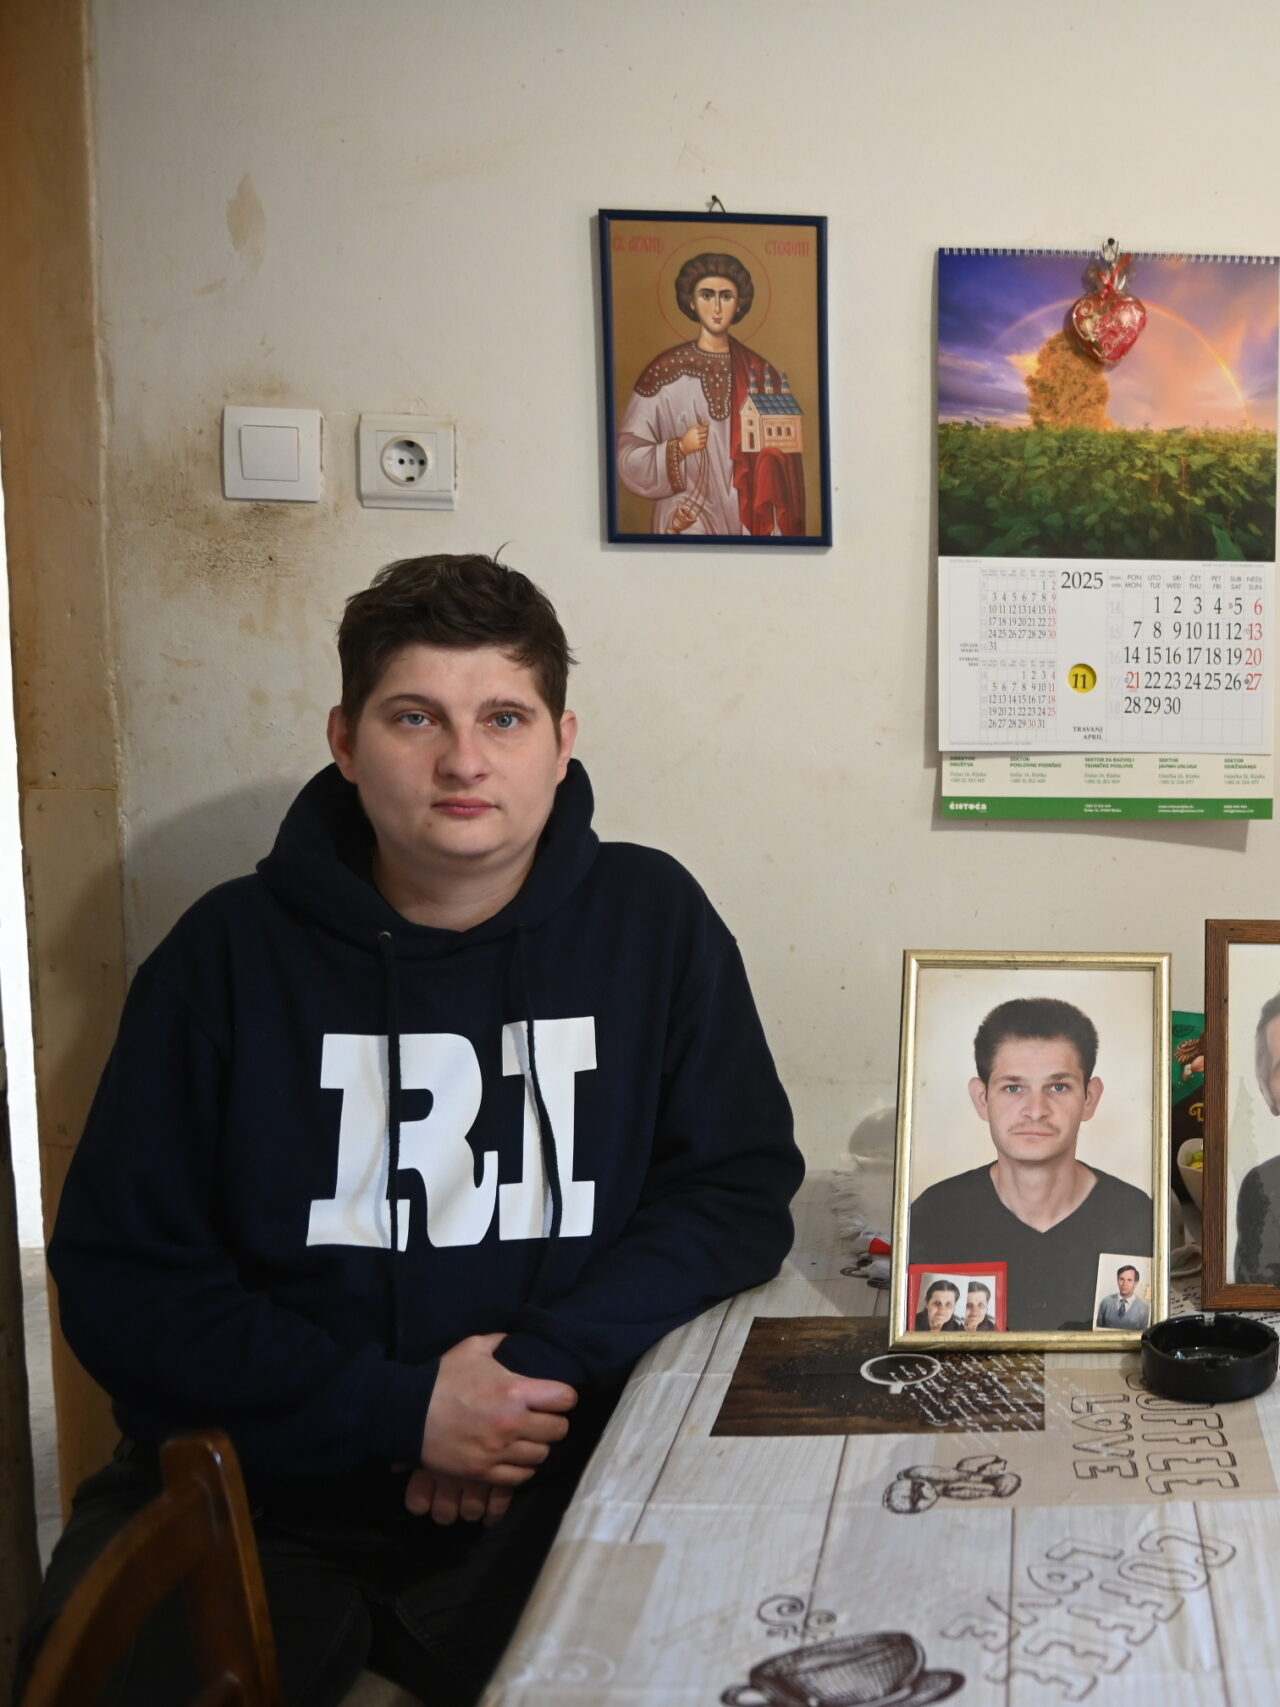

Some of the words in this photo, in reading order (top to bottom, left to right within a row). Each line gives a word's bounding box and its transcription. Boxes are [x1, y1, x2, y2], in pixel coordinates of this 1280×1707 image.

[1052, 580, 1057, 591] 2
[1061, 571, 1104, 590] 2025
[992, 592, 997, 602] 3
[1002, 592, 1007, 602] 4
[1012, 592, 1017, 602] 5
[1022, 593, 1027, 602] 6
[1032, 592, 1036, 602] 7
[1042, 593, 1047, 602] 8
[1051, 593, 1057, 602] 9
[989, 604, 998, 613] 10
[999, 605, 1006, 614] 11
[1009, 604, 1017, 614] 12
[1019, 605, 1027, 614] 13
[1028, 605, 1036, 615] 14
[1039, 605, 1047, 614] 15
[1048, 605, 1057, 615] 16
[1155, 596, 1160, 614] 1
[1173, 596, 1182, 613] 2
[1194, 596, 1202, 614] 3
[1214, 598, 1222, 614] 4
[1234, 598, 1242, 615] 5
[1254, 599, 1263, 615] 6
[989, 616, 997, 626] 17
[999, 617, 1007, 626] 18
[1009, 617, 1017, 626] 19
[1018, 617, 1027, 627] 20
[1027, 617, 1035, 627] 21
[1038, 617, 1046, 627] 22
[1047, 617, 1057, 627] 23
[988, 629, 997, 638] 24
[998, 629, 1007, 639] 25
[1008, 629, 1017, 639] 26
[1018, 629, 1027, 639] 27
[1027, 629, 1036, 639] 28
[1038, 629, 1047, 639] 29
[1048, 629, 1057, 639] 30
[1134, 621, 1142, 638] 7
[1153, 622, 1162, 638] 8
[1173, 622, 1182, 639] 9
[1187, 622, 1202, 640] 10
[1207, 622, 1219, 640] 11
[1227, 623, 1242, 640] 12
[1248, 623, 1262, 640] 13
[989, 641, 997, 651] 31
[1125, 647, 1140, 663] 14
[1146, 647, 1161, 664] 15
[1166, 647, 1181, 664] 16
[1187, 647, 1202, 664] 17
[1206, 648, 1221, 664] 18
[1227, 648, 1242, 665] 19
[1245, 648, 1262, 666] 20
[1031, 670, 1036, 680] 2
[1042, 670, 1047, 680] 3
[1051, 671, 1056, 680] 4
[1072, 673, 1088, 690] 11
[1126, 672, 1140, 689] 21
[1144, 672, 1161, 689] 22
[1165, 672, 1181, 690] 23
[1185, 672, 1201, 689] 24
[1204, 672, 1221, 690] 25
[1225, 673, 1242, 690] 26
[1246, 673, 1262, 691] 27
[992, 682, 997, 691] 5
[1002, 683, 1007, 692] 6
[1012, 682, 1017, 692] 7
[1022, 683, 1027, 691] 8
[1031, 683, 1036, 691] 9
[1039, 683, 1047, 692] 10
[1048, 683, 1055, 693] 11
[989, 694, 997, 704] 12
[999, 694, 1007, 704] 13
[1009, 695, 1017, 704] 14
[1018, 694, 1027, 704] 15
[1028, 695, 1036, 704] 16
[1038, 695, 1047, 704] 17
[1048, 695, 1056, 704] 18
[1124, 696, 1141, 713] 28
[1144, 697, 1161, 714] 29
[1164, 697, 1181, 715] 30
[989, 707, 997, 716] 19
[998, 707, 1007, 716] 20
[1008, 706, 1016, 716] 21
[1018, 706, 1026, 717] 22
[1027, 707, 1036, 717] 23
[1038, 707, 1046, 716] 24
[1047, 707, 1056, 717] 25
[988, 719, 997, 729] 26
[998, 718, 1007, 729] 27
[1009, 719, 1017, 728] 28
[1018, 719, 1027, 729] 29
[1028, 719, 1036, 728] 30
[1038, 719, 1045, 729] 31
[1070, 1393, 1139, 1480] LOVE
[985, 1525, 1237, 1702] COFFEE
